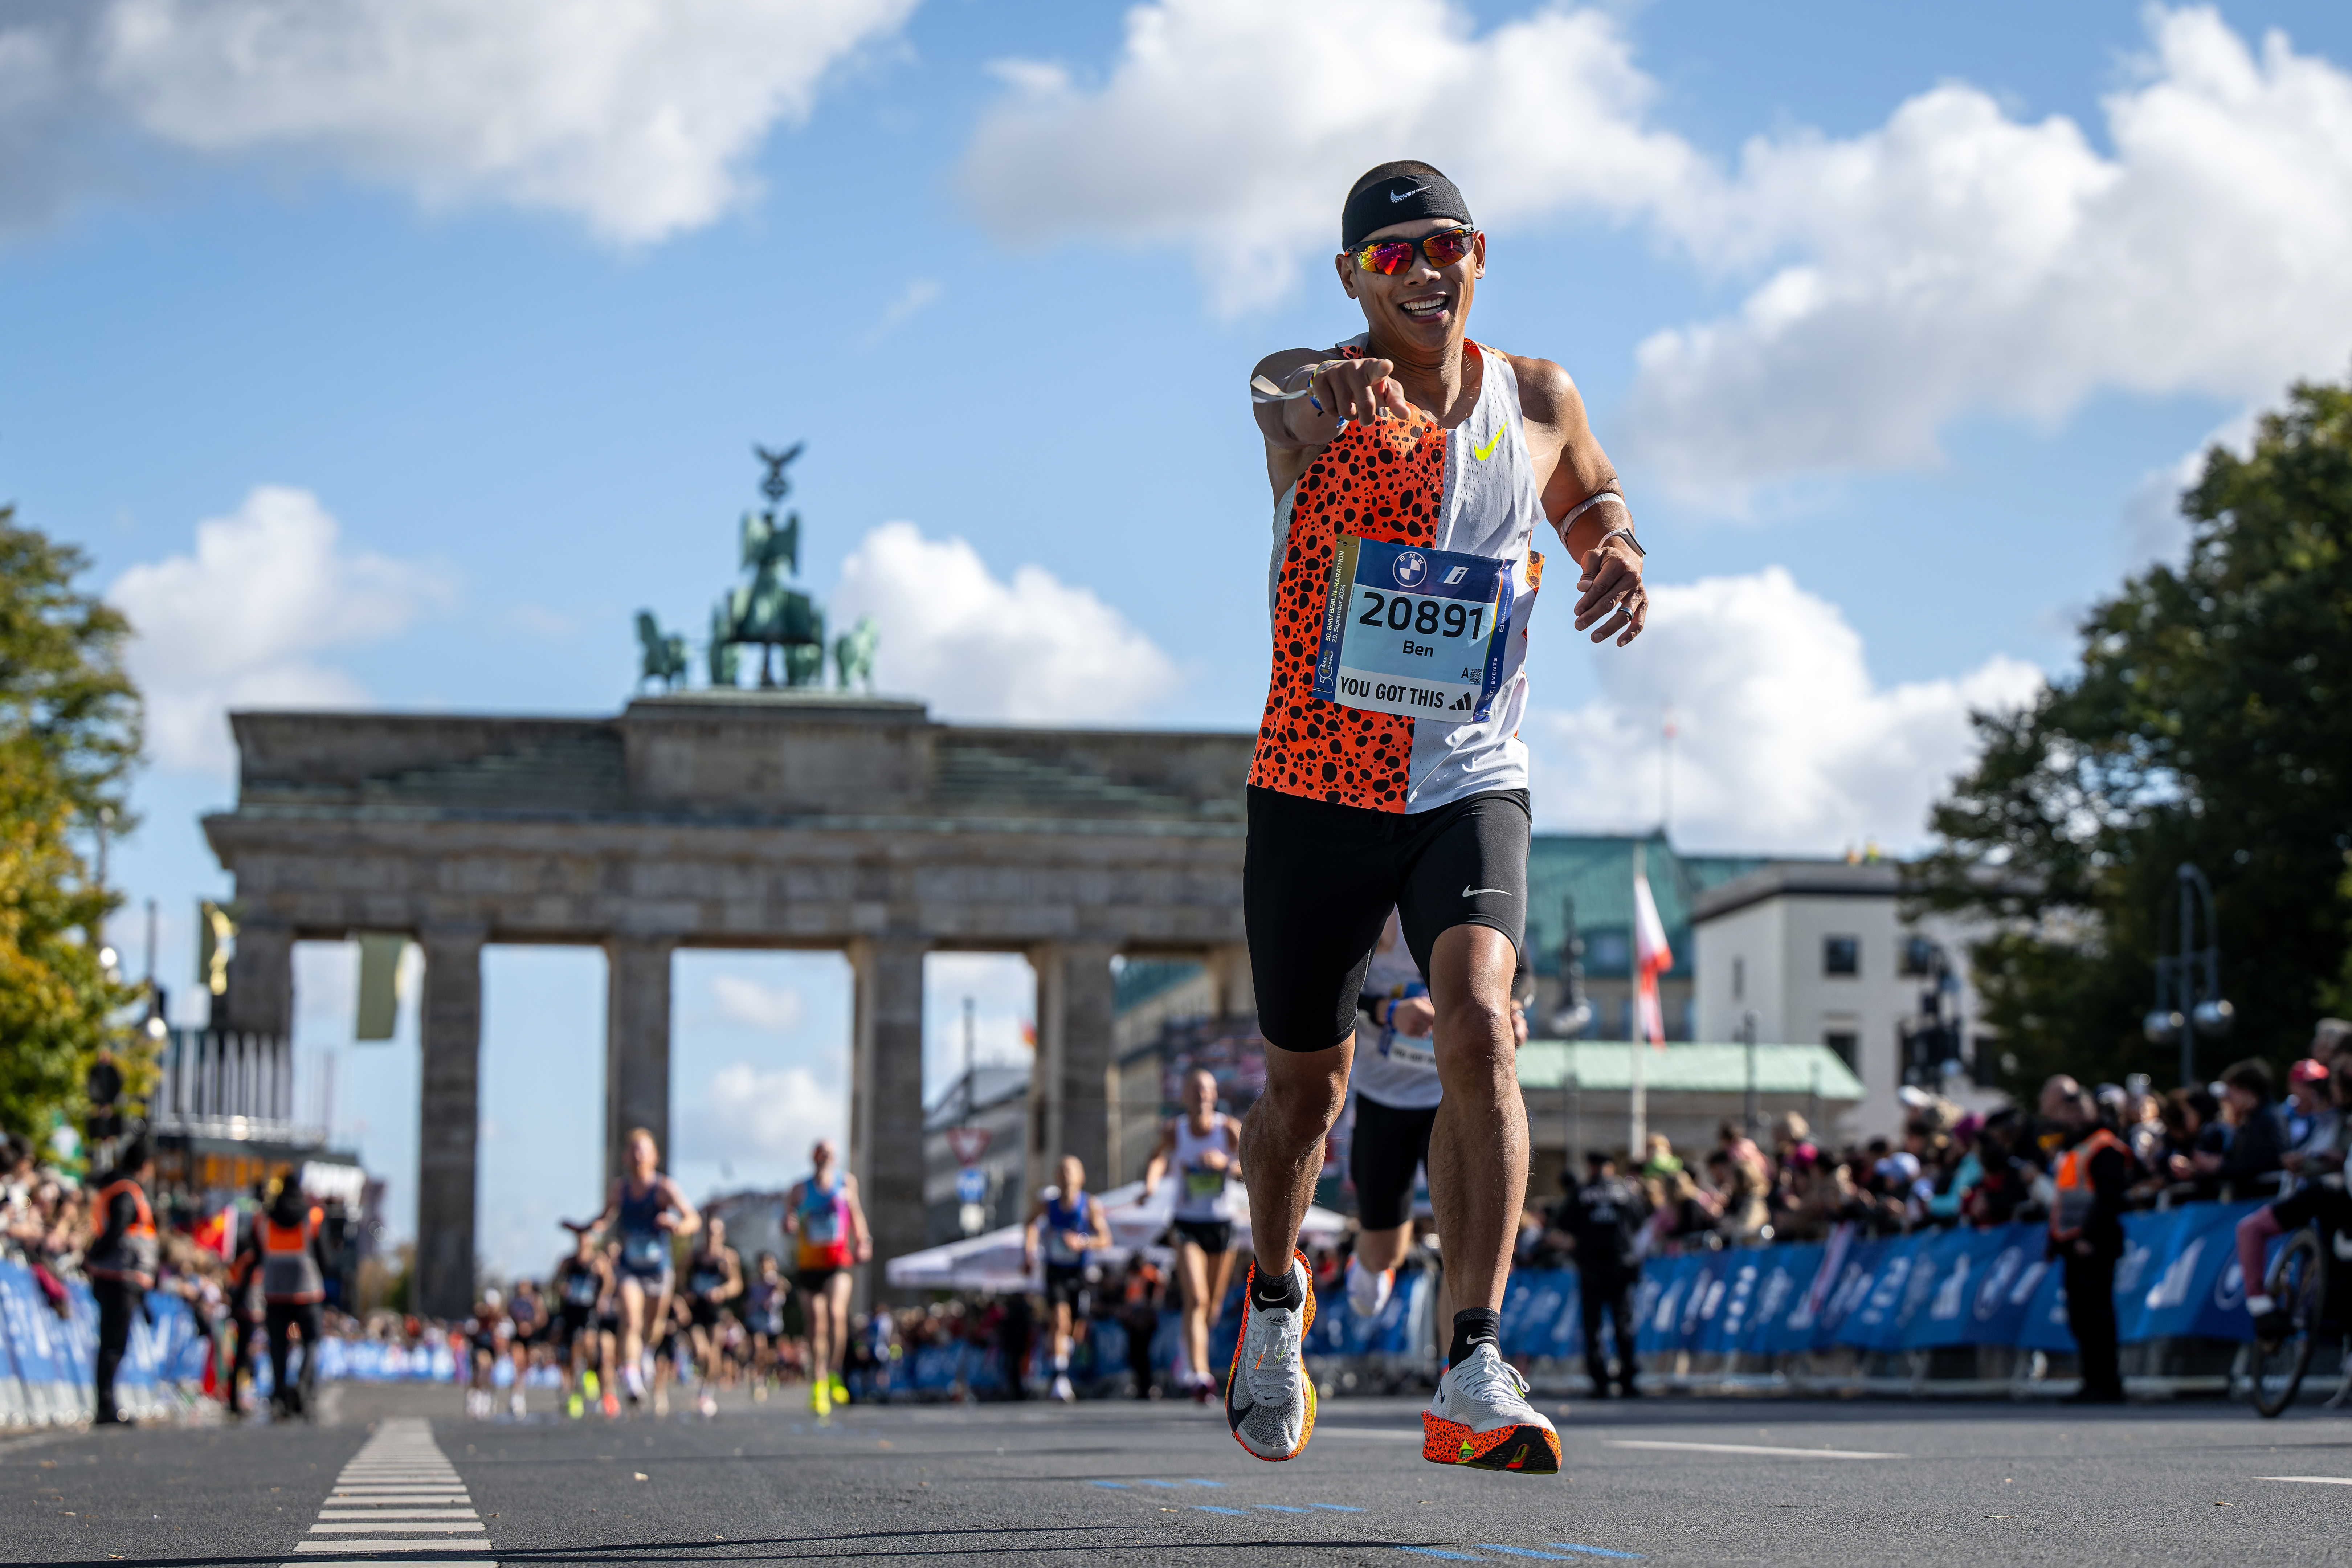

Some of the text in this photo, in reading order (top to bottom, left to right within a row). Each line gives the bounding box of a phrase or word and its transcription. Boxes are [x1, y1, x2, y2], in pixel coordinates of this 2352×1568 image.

[1399, 553, 1424, 564] BMW
[1329, 551, 1344, 613] BERLIN-MARATHON
[1334, 600, 1343, 633] September
[1359, 592, 1483, 640] 20891
[1402, 640, 1434, 657] Ben
[1461, 667, 1469, 678] A
[1341, 676, 1445, 709] YOU GOT THIS
